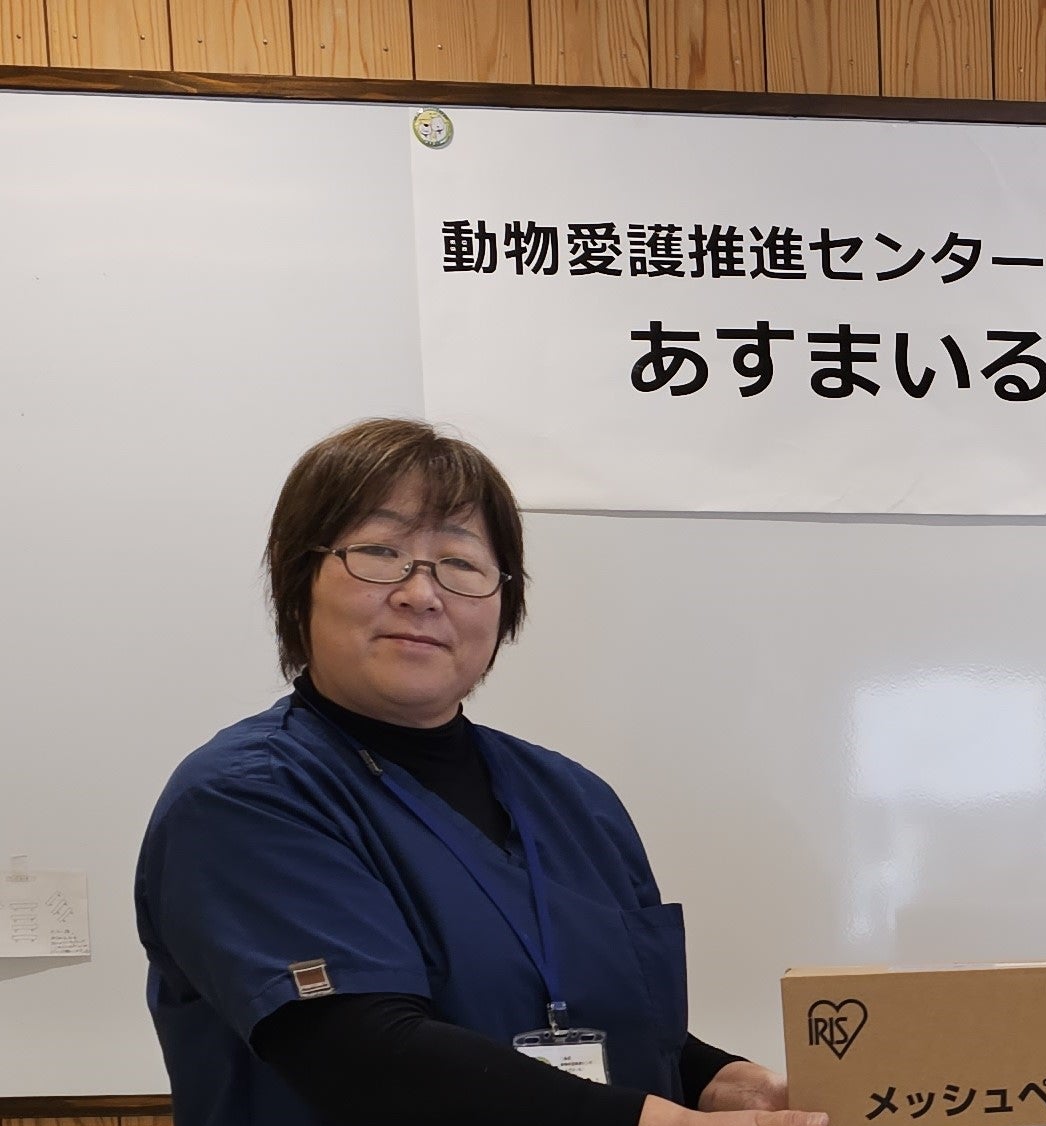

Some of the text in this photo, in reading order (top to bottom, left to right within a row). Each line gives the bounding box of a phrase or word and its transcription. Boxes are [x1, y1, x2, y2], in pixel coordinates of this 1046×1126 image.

[441, 219, 1044, 284] 動物愛護推進センター
[808, 1017, 848, 1046] IRIS
